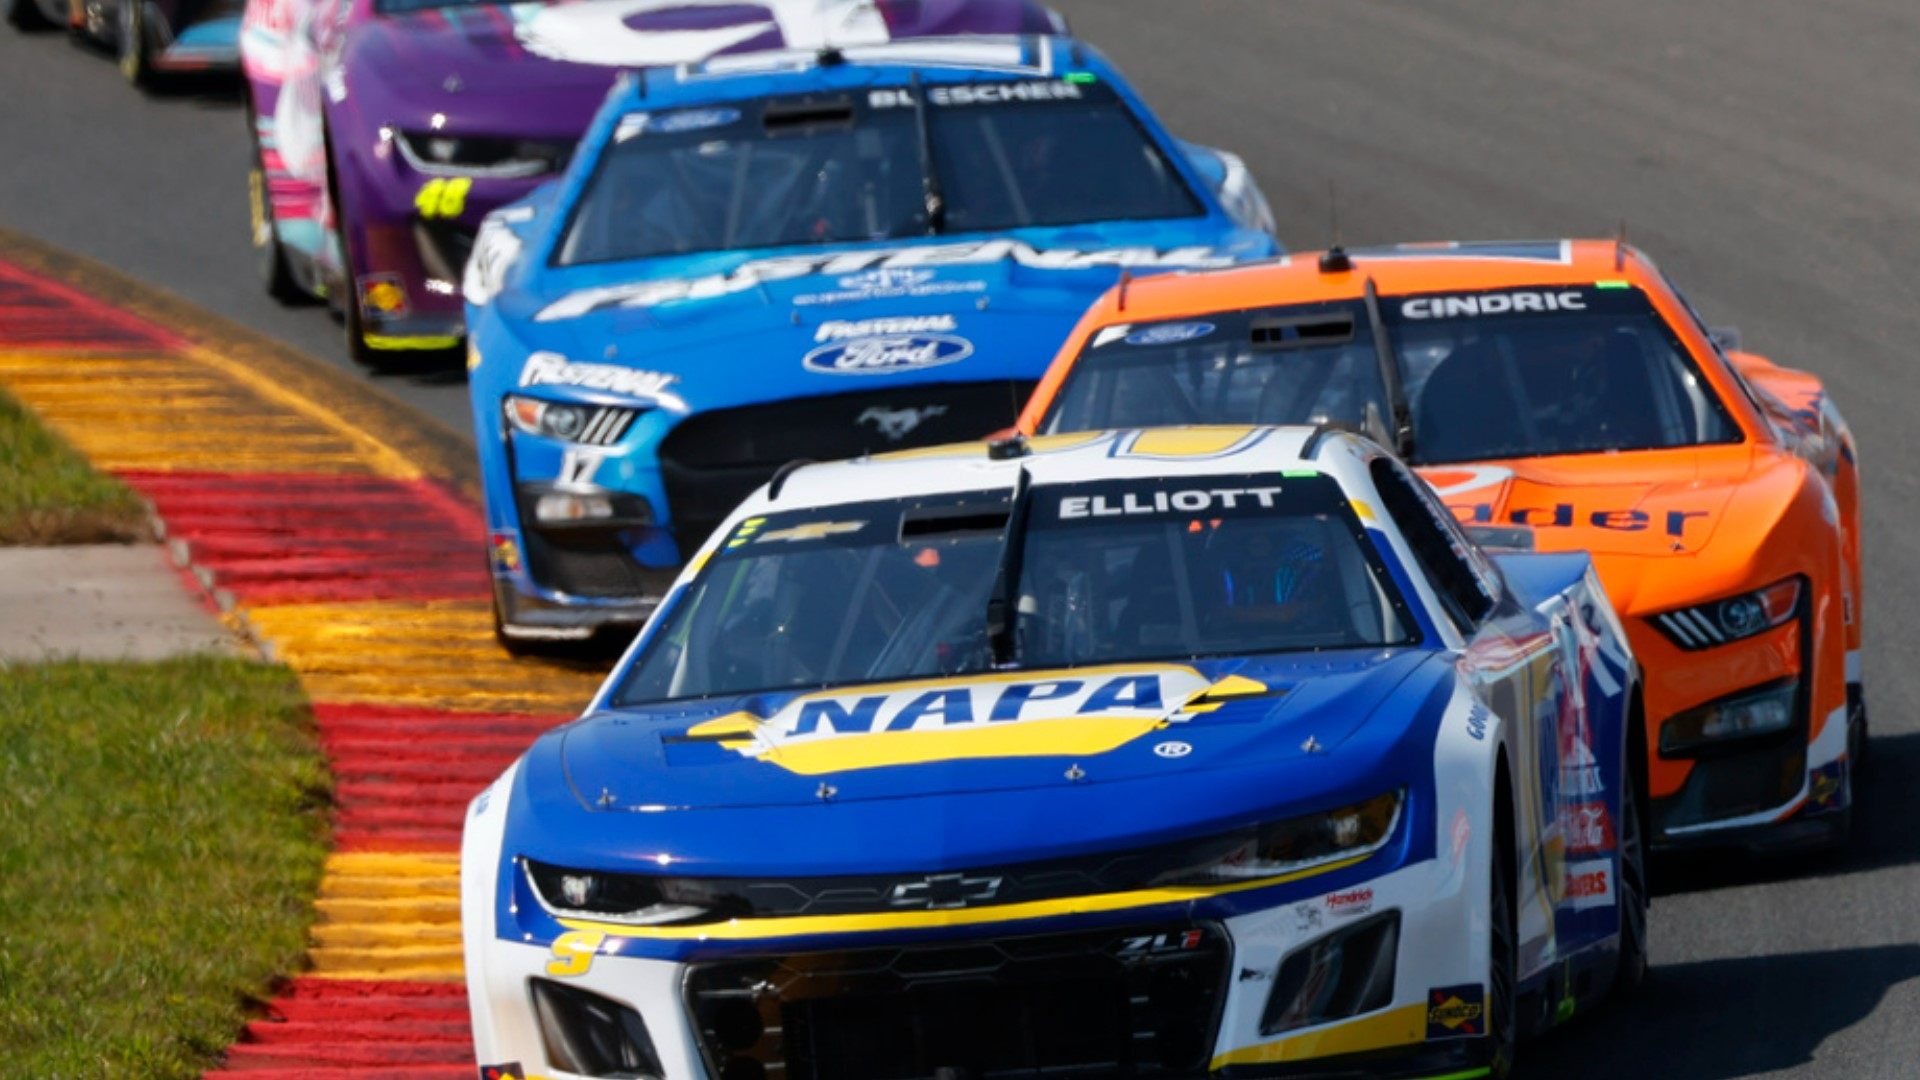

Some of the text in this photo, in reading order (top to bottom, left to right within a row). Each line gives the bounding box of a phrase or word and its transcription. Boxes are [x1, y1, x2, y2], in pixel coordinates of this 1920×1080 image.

[1402, 291, 1587, 319] CINDRIC
[553, 449, 606, 494] 17
[1058, 487, 1283, 519] ELLIOTT
[785, 674, 1164, 738] NAPA
[546, 930, 606, 976] 9
